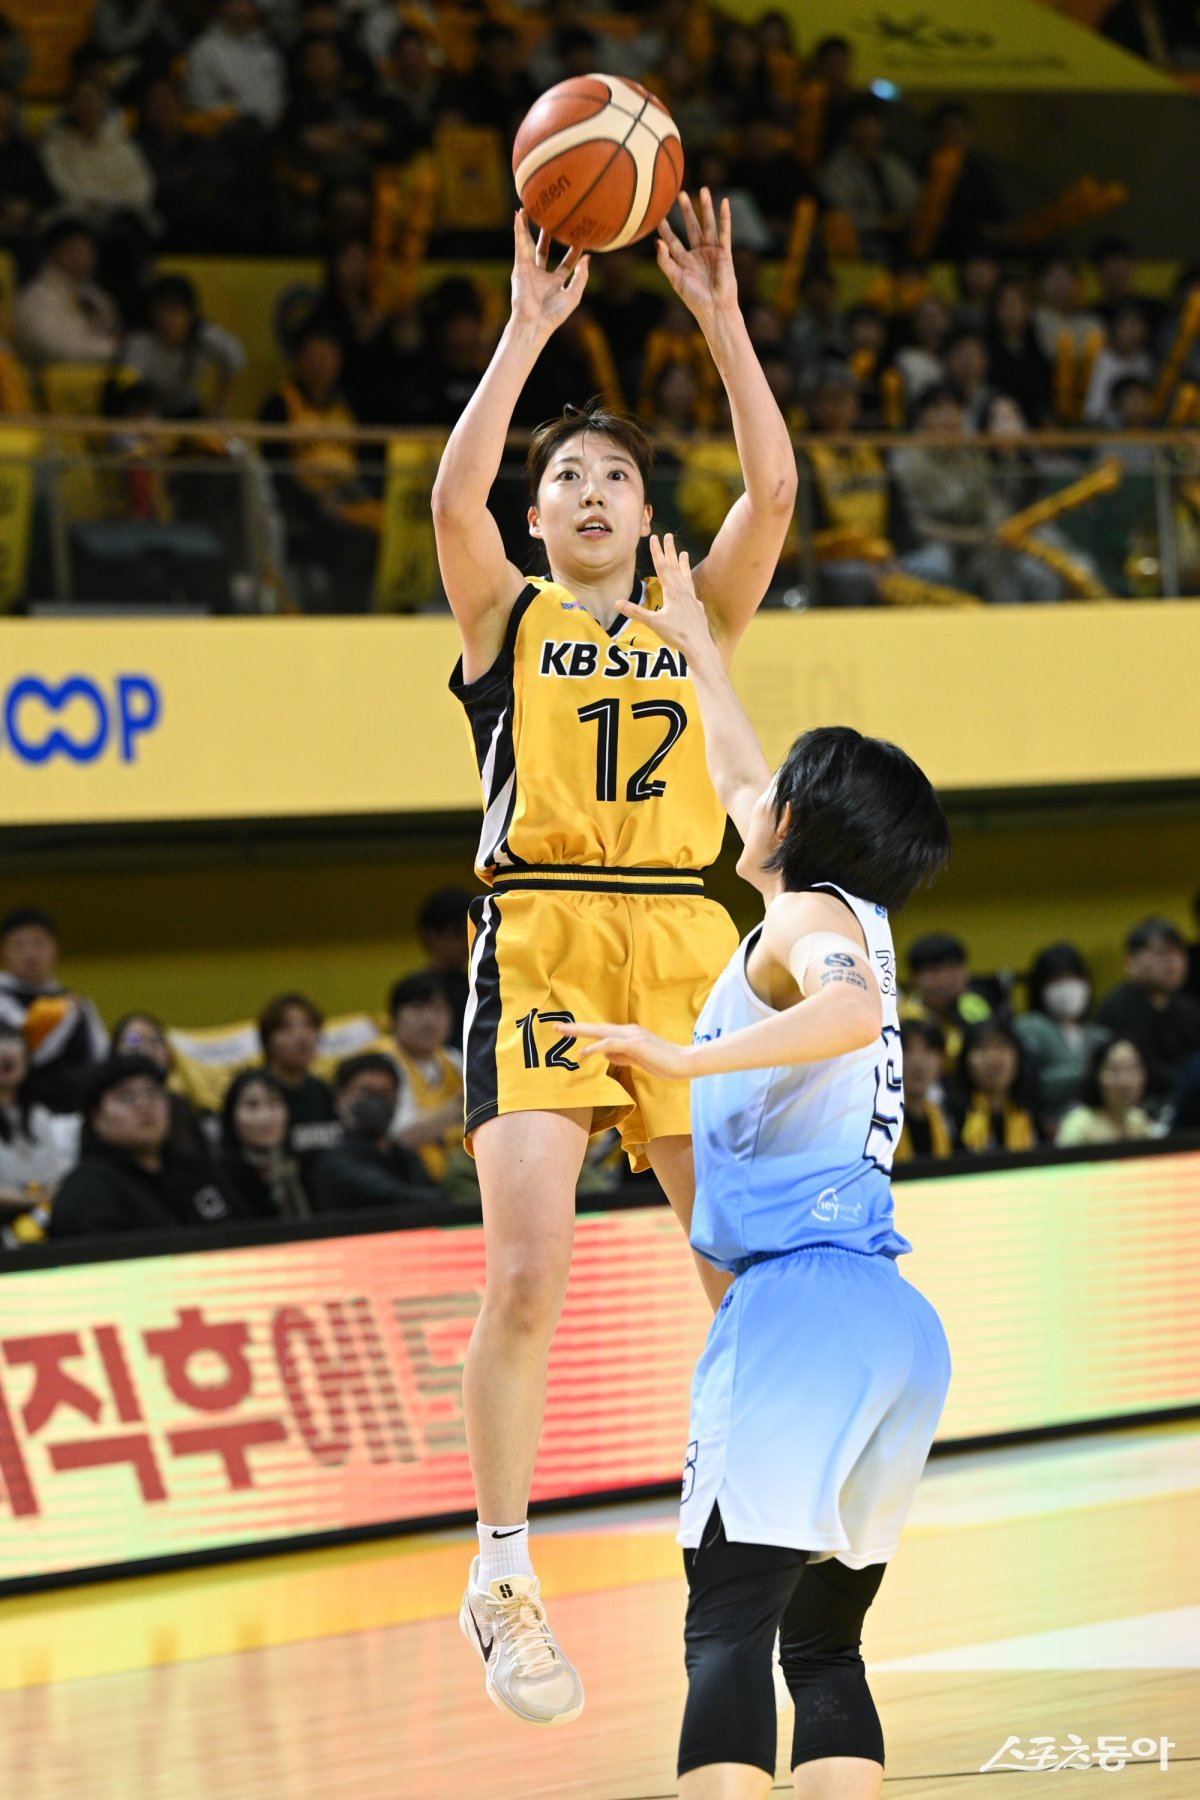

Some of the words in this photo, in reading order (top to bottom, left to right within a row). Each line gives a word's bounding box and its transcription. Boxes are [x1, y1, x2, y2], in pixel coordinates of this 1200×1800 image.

[539, 641, 600, 678] KB
[0, 673, 163, 766] OOP
[577, 698, 688, 802] 12
[515, 1008, 580, 1071] 12
